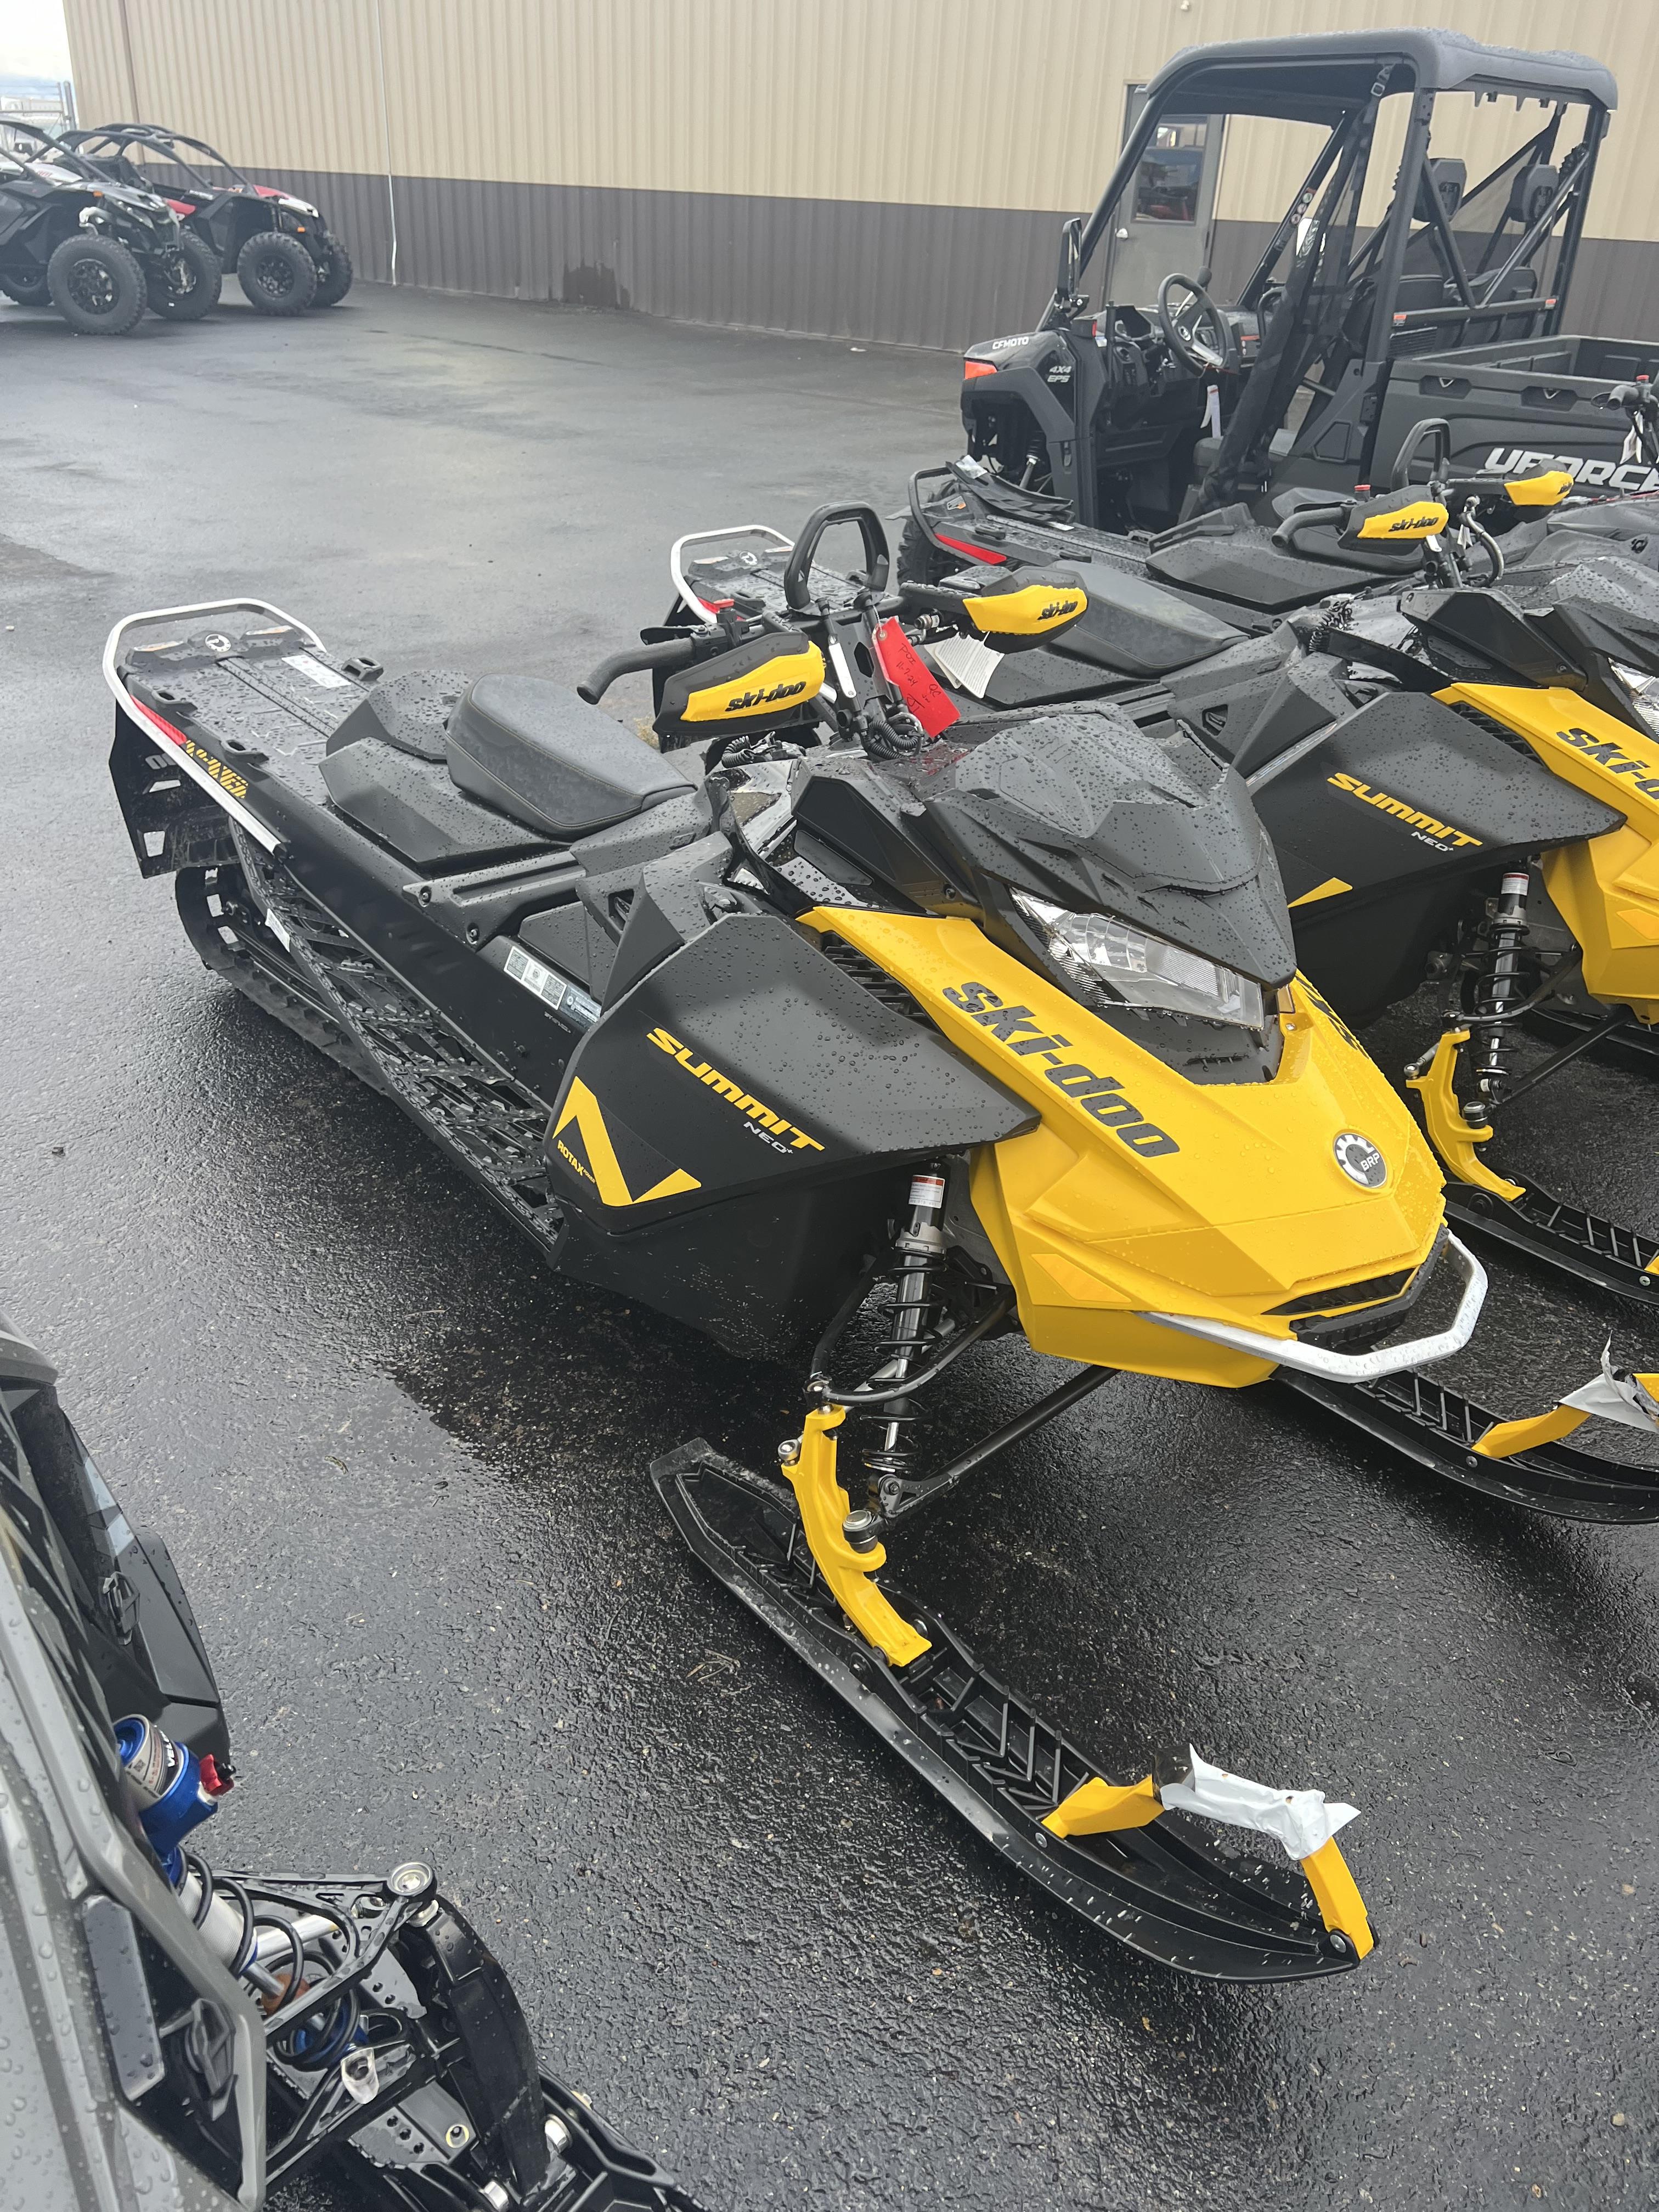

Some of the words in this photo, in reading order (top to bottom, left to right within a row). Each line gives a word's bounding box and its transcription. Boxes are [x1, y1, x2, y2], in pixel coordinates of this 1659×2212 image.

[992, 336, 1029, 349] CFMOTO
[1047, 375, 1071, 383] EPS
[1387, 516, 1440, 532] ski-doo
[724, 681, 806, 712] ski-doo
[1327, 772, 1483, 847] SUMMIT
[942, 981, 1181, 1158] ski-doo
[646, 1028, 825, 1151] SUMMIT
[557, 1139, 584, 1176] ROTAX
[1360, 1152, 1380, 1171] BRP
